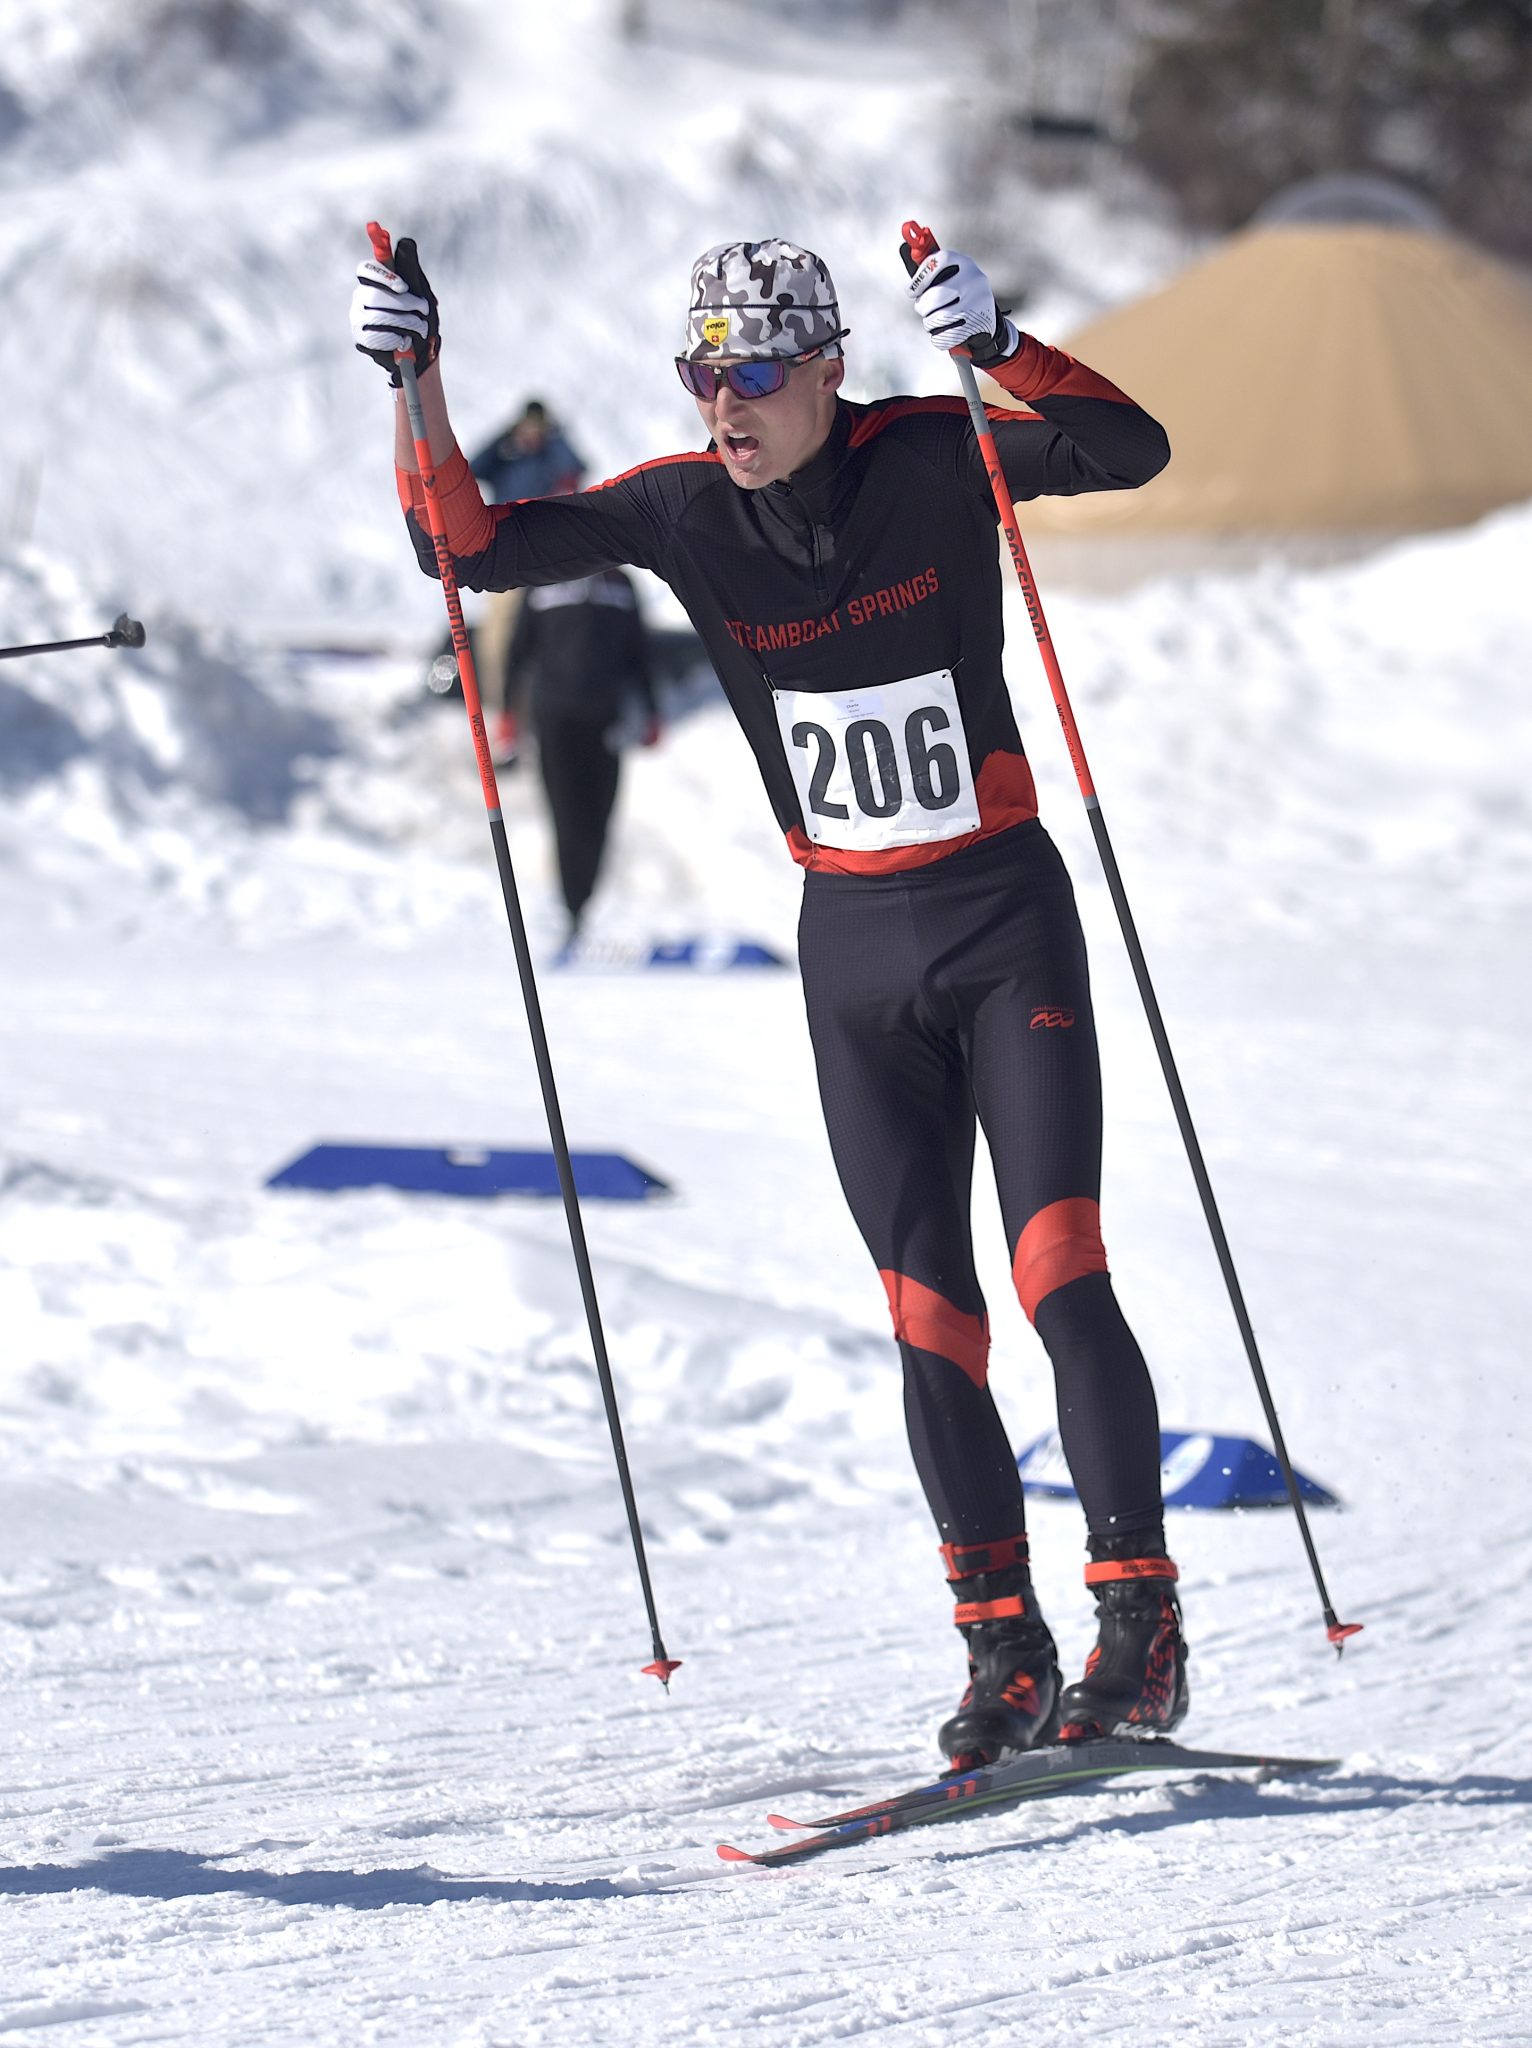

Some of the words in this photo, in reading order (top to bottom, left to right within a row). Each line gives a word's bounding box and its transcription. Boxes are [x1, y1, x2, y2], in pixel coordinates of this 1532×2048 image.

[433, 533, 471, 659] ROSSIGNOL
[847, 566, 940, 626] SPRINGS
[472, 712, 484, 738] WCS
[791, 705, 960, 820] 206
